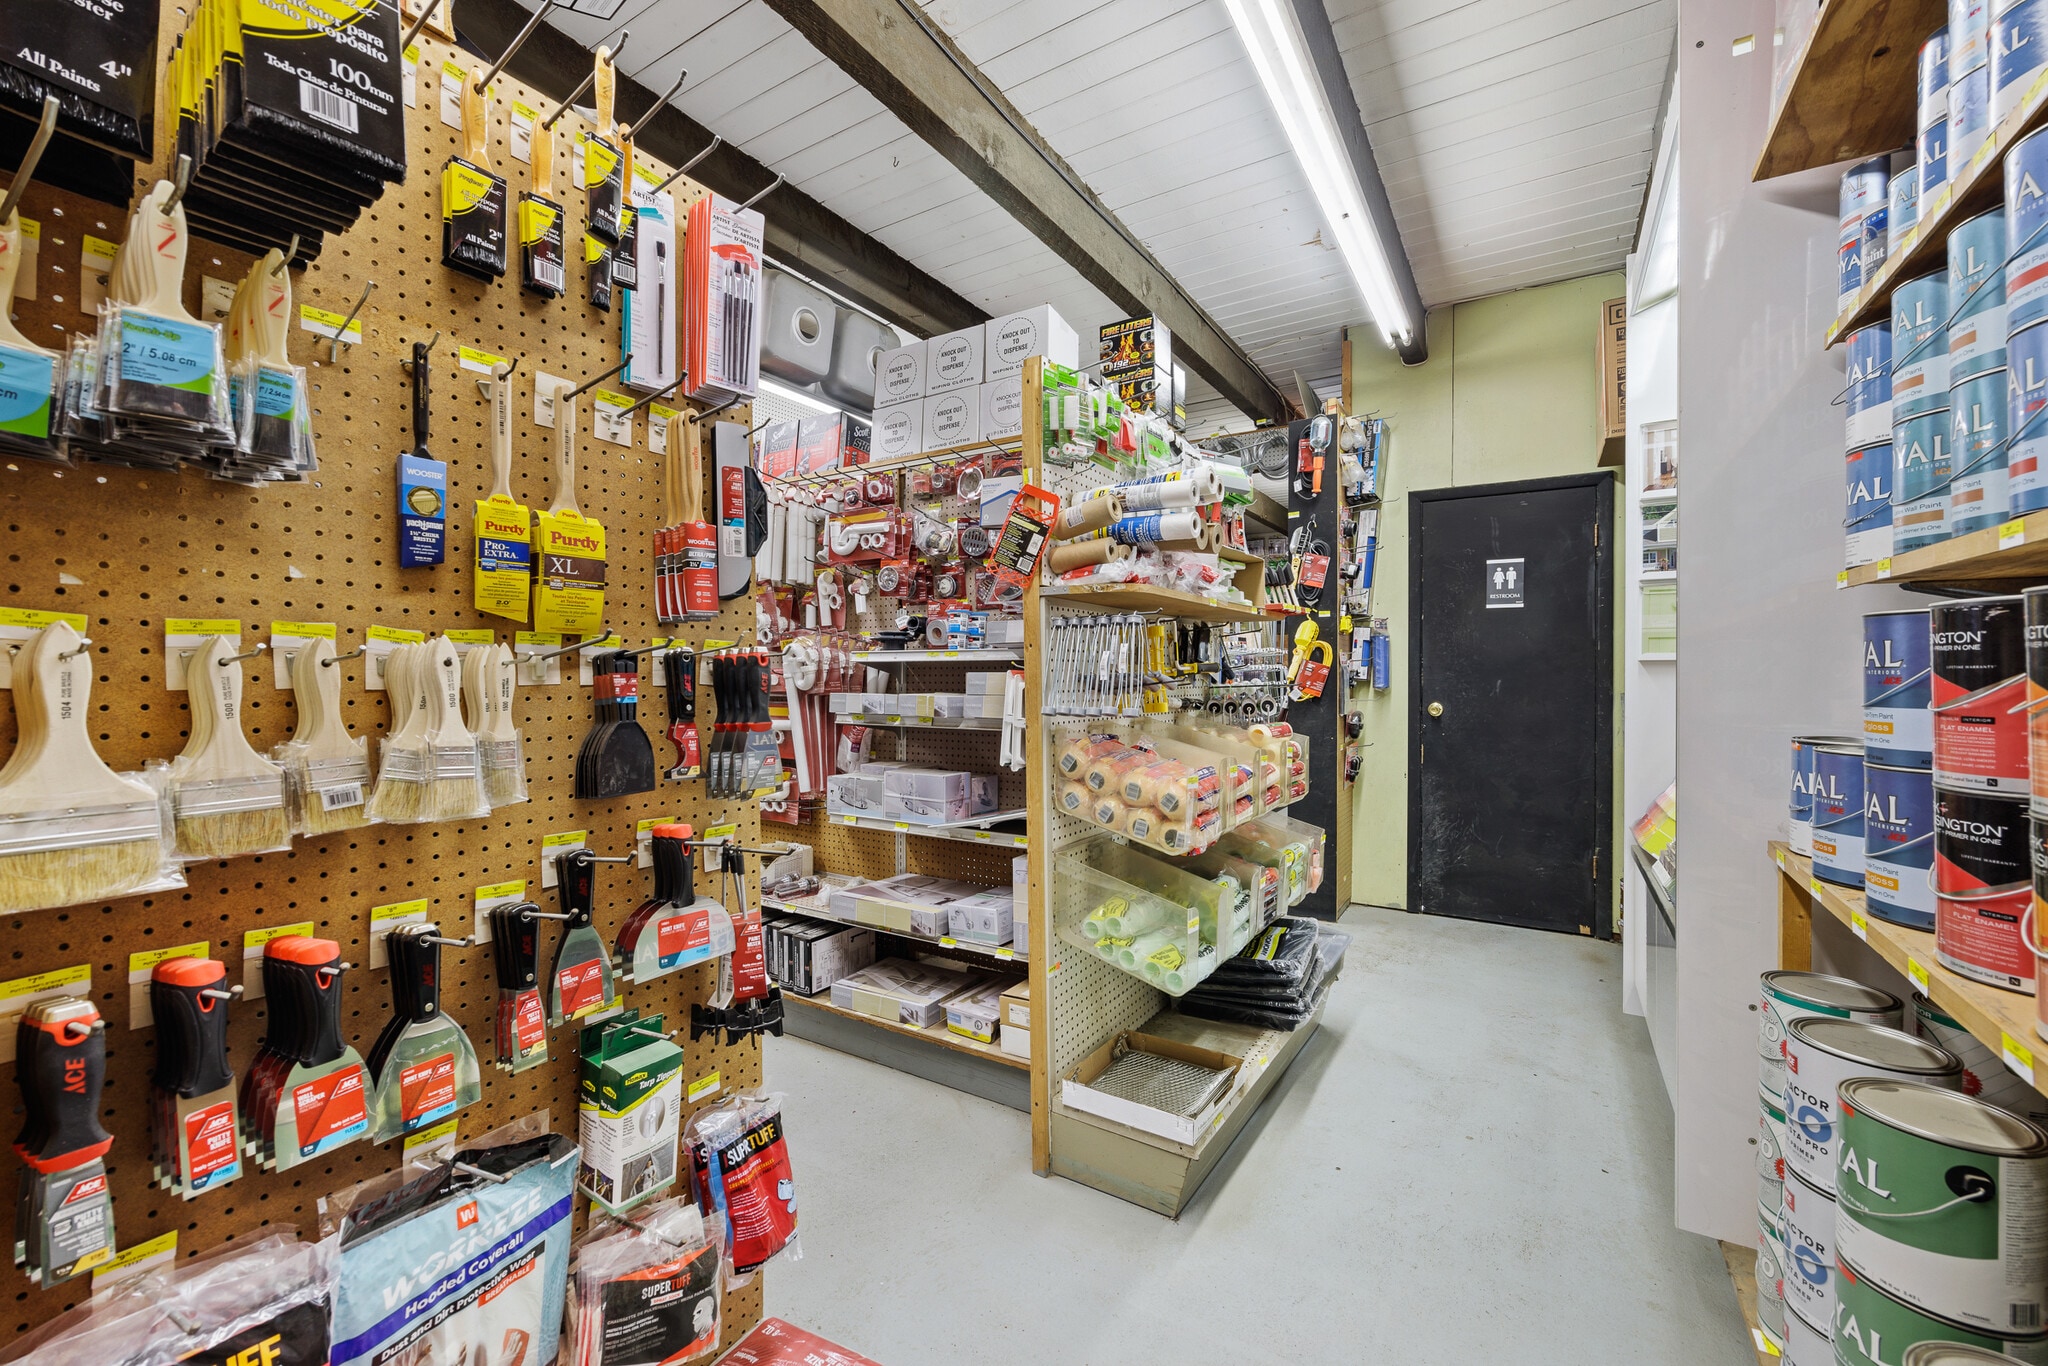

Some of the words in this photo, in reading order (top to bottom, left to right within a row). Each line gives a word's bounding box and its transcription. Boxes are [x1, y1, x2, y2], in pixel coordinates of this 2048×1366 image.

[306, 18, 389, 64] propósito
[346, 23, 385, 49] para
[17, 47, 46, 69] All
[48, 58, 101, 93] Paints
[264, 52, 297, 75] Toda
[297, 67, 329, 89] Clase
[329, 83, 343, 96] de
[344, 88, 389, 116] Pinturas
[712, 213, 731, 225] ARTIST
[1001, 330, 1020, 340] KNOCK
[1019, 326, 1031, 336] OUT
[1100, 325, 1120, 338] FIRE
[1118, 316, 1153, 332] LITERS
[1012, 337, 1020, 345] TO
[940, 348, 957, 358] KNOCK
[956, 345, 967, 354] OUT
[1003, 342, 1029, 356] DISPENSE
[148, 348, 176, 364] 5.08
[179, 356, 198, 368] cm
[949, 355, 957, 363] TO
[888, 365, 903, 375] KNOCK
[902, 362, 913, 371] OUT
[942, 360, 965, 372] DISPENSE
[896, 371, 904, 379] TO
[889, 377, 911, 388] DISPENSE
[995, 393, 1011, 402] KNOCK
[1010, 390, 1022, 399] OUT
[937, 407, 953, 417] KNOCK
[952, 404, 963, 414] OUT
[997, 401, 1021, 414] DISPENSE
[945, 414, 954, 422] TO
[938, 420, 961, 432] DISPENSE
[406, 466, 444, 480] WOOSTER
[1965, 479, 1982, 489] Paint
[1918, 501, 1943, 511] Paint
[1968, 504, 1982, 513] One
[484, 520, 526, 536] Purdy
[1926, 523, 1942, 532] One
[484, 540, 510, 551] PRO-
[550, 530, 600, 552] Purdy
[687, 537, 717, 548] WOOSTER
[1961, 643, 1981, 651] ONE
[61, 700, 71, 720] 1504
[226, 702, 235, 720] 1500
[1878, 712, 1894, 721] Paint
[1939, 724, 1956, 732] FLAT
[1957, 725, 1996, 734] ENAMEL
[1878, 736, 1891, 744] One
[1828, 806, 1845, 815] ACE
[1887, 831, 1909, 843] ACE
[1944, 831, 1969, 842] PRIMER
[1979, 837, 2002, 846] ONE
[1882, 866, 1899, 877] Paint
[1883, 892, 1896, 901] One
[1952, 911, 1972, 923] FLAT
[1974, 917, 2018, 933] ENAMEL
[1980, 910, 2015, 921] INTERIOR
[696, 920, 708, 929] ACE
[747, 923, 759, 931] ACE
[588, 967, 600, 976] ACE
[437, 1063, 452, 1074] ACE
[62, 1057, 87, 1095] ACE
[638, 1077, 656, 1091] Tarp
[655, 1067, 680, 1084] Zipper
[341, 1076, 360, 1090] ACE
[208, 1115, 230, 1130] ACE
[1804, 1138, 1829, 1156] PRO
[76, 1178, 103, 1196] ACE
[460, 1207, 477, 1221] W
[403, 1272, 467, 1320] Hooded
[467, 1230, 525, 1277] Coverall
[484, 1263, 532, 1302] BREATHABLE
[1803, 1278, 1825, 1299] PRO
[380, 1339, 410, 1363] Dust
[408, 1320, 433, 1342] and
[434, 1305, 456, 1326] Dirt
[455, 1269, 508, 1311] Protective
[507, 1249, 537, 1273] Wear
